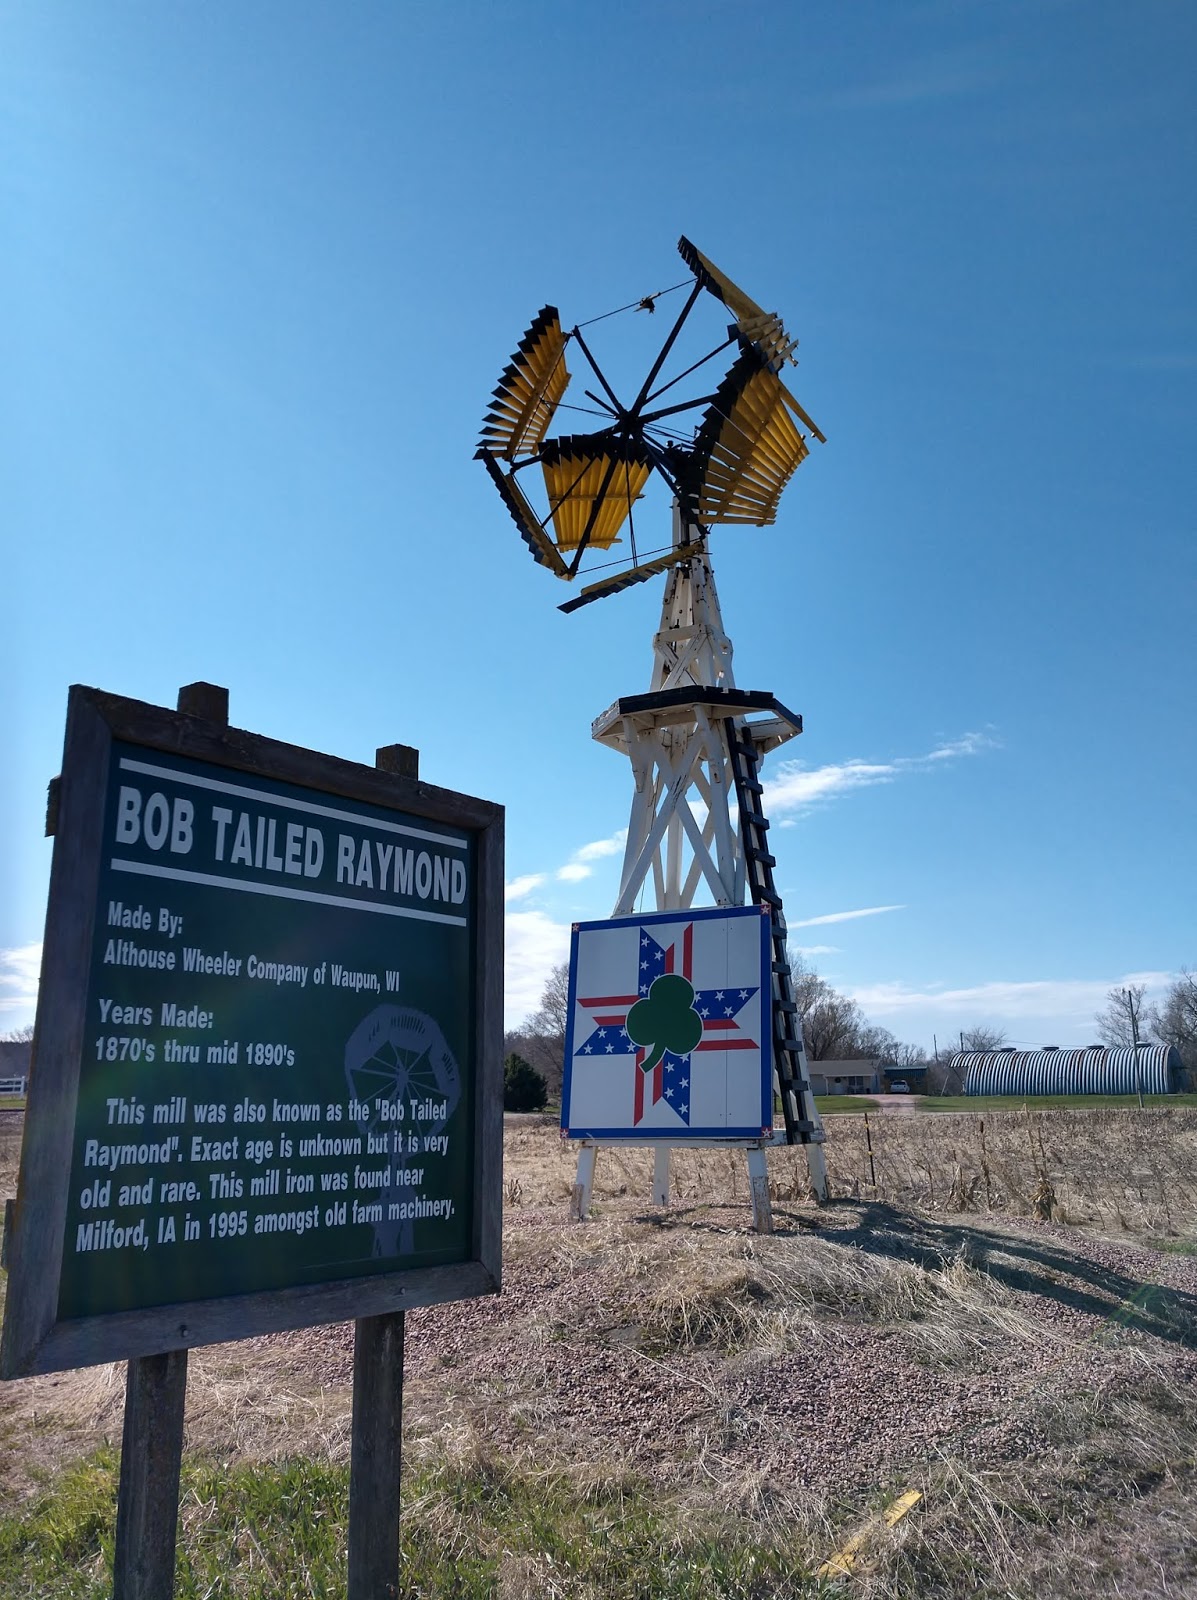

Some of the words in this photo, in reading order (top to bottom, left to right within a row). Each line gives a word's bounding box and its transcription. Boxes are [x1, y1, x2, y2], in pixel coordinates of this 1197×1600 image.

[115, 785, 195, 855] BOB
[211, 806, 324, 878] TAILED
[336, 834, 467, 905] RAYMOND
[107, 901, 151, 931] Made
[158, 908, 183, 939] By:
[104, 939, 176, 970] Althouse
[183, 947, 242, 976] Wheeler
[247, 955, 308, 986] Company
[313, 963, 326, 984] of
[331, 964, 381, 993] Waupun,
[386, 971, 400, 992] WI
[98, 999, 152, 1026] Years
[161, 1004, 214, 1028] Made:
[95, 1037, 155, 1062] 1870's
[164, 1040, 200, 1063] thru
[207, 1041, 238, 1064] mid
[246, 1043, 295, 1066] 1890's
[106, 1098, 145, 1125] This
[153, 1097, 186, 1124] mill
[194, 1103, 226, 1123] was
[233, 1099, 266, 1123] also
[272, 1100, 320, 1122] known
[326, 1103, 342, 1121] as
[348, 1101, 370, 1121] the
[374, 1101, 404, 1121] "Bob
[409, 1100, 447, 1121] Tailed
[84, 1137, 183, 1171] Raymond".
[191, 1137, 239, 1162] Exact
[245, 1140, 273, 1164] age
[279, 1133, 293, 1158] is
[299, 1134, 361, 1157] unknown
[367, 1132, 388, 1154] but
[393, 1131, 403, 1153] it
[408, 1130, 419, 1153] is
[423, 1135, 449, 1157] very
[80, 1180, 111, 1209] old
[118, 1178, 154, 1206] and
[160, 1179, 200, 1202] rare.
[210, 1173, 243, 1200] This
[251, 1170, 279, 1195] mill
[285, 1170, 314, 1193] iron
[320, 1172, 348, 1191] was
[354, 1165, 391, 1189] found
[396, 1167, 424, 1187] near
[76, 1219, 149, 1252] Milford,
[157, 1216, 176, 1244] IA
[184, 1214, 200, 1240] in
[209, 1210, 248, 1238] 1995
[254, 1205, 320, 1235] amongst
[325, 1202, 347, 1227] old
[352, 1200, 383, 1223] farm
[388, 1194, 455, 1221] machinery.
